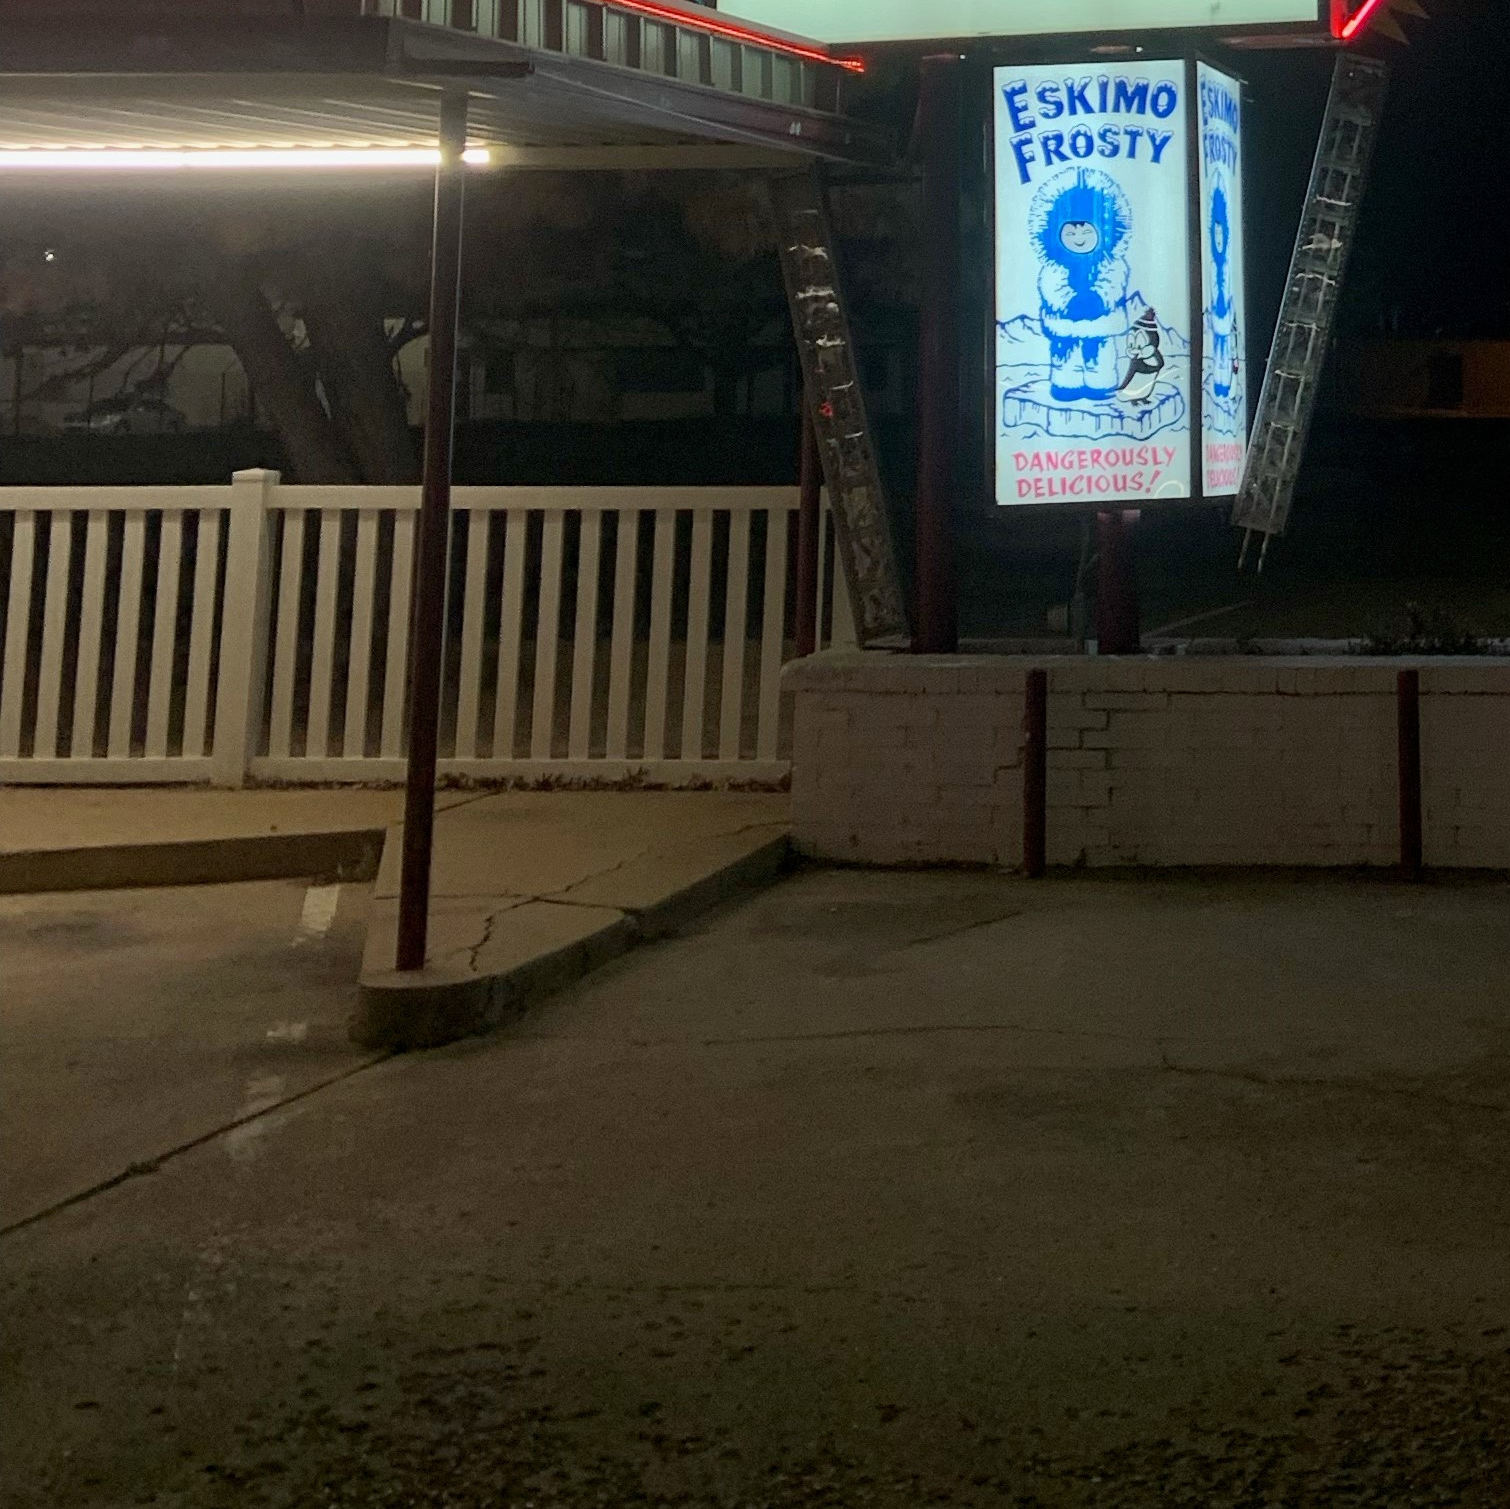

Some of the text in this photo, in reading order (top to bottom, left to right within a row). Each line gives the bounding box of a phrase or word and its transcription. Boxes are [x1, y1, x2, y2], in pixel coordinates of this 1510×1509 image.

[1001, 75, 1177, 134] ESKIMO
[1010, 124, 1174, 184] FROSTY
[1011, 446, 1177, 473] DANGEROUSLY
[1016, 470, 1161, 499] DELICIOUS!
